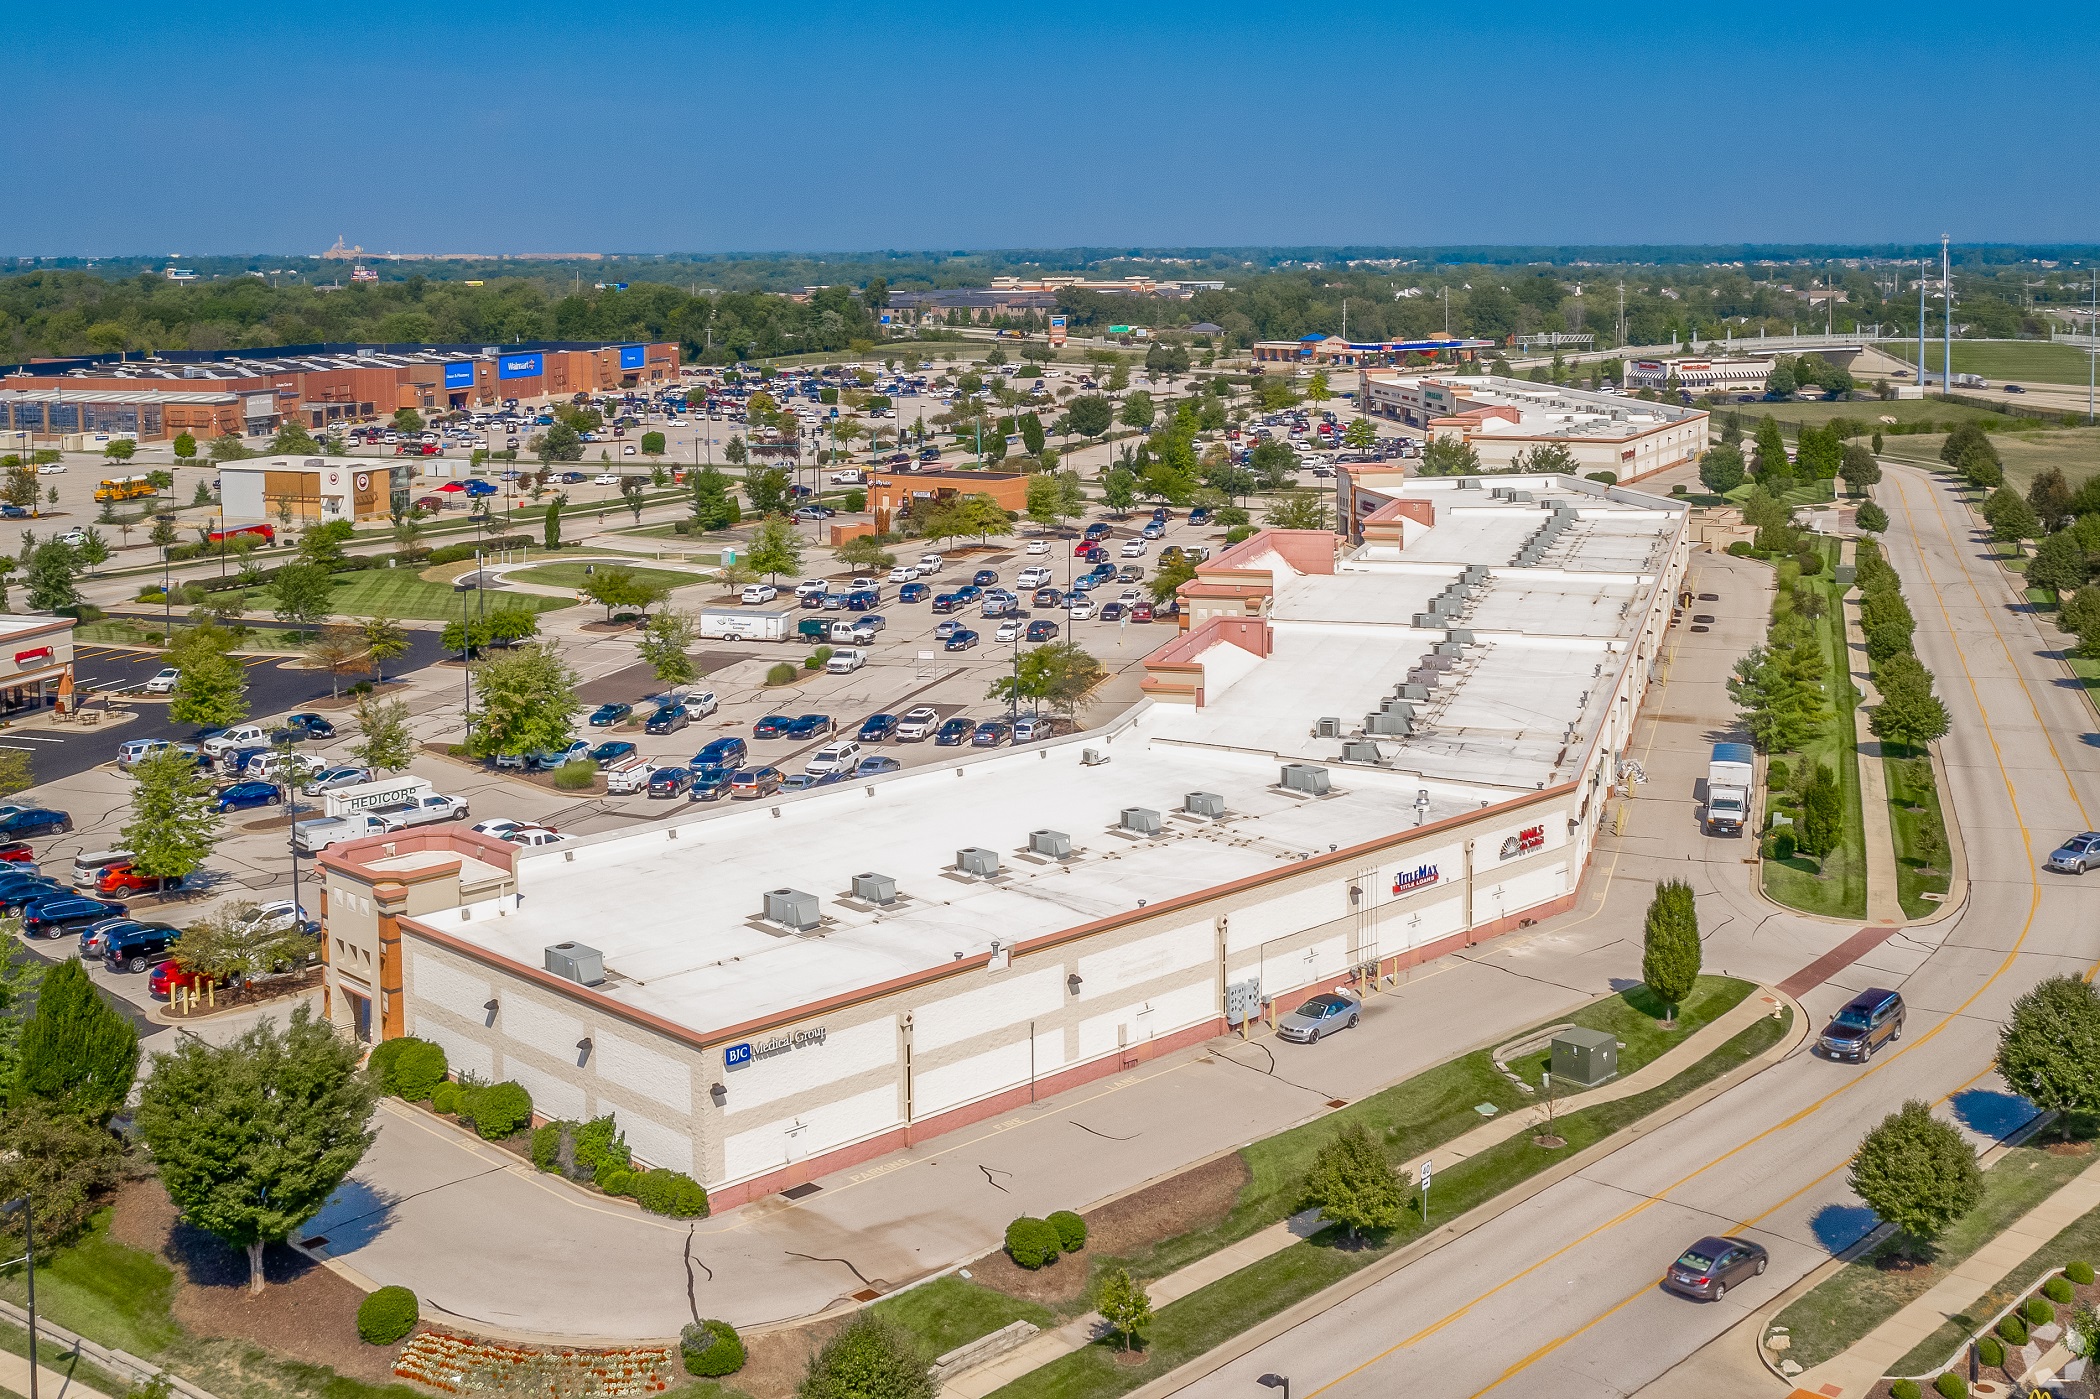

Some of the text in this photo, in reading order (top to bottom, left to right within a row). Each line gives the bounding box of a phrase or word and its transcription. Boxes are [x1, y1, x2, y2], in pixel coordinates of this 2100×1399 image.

[507, 361, 529, 370] Walmart
[1416, 875, 1435, 886] LOANS
[729, 1027, 826, 1062] BJC Medical Group
[850, 1075, 1141, 1182] PARKING FIRE LANE
